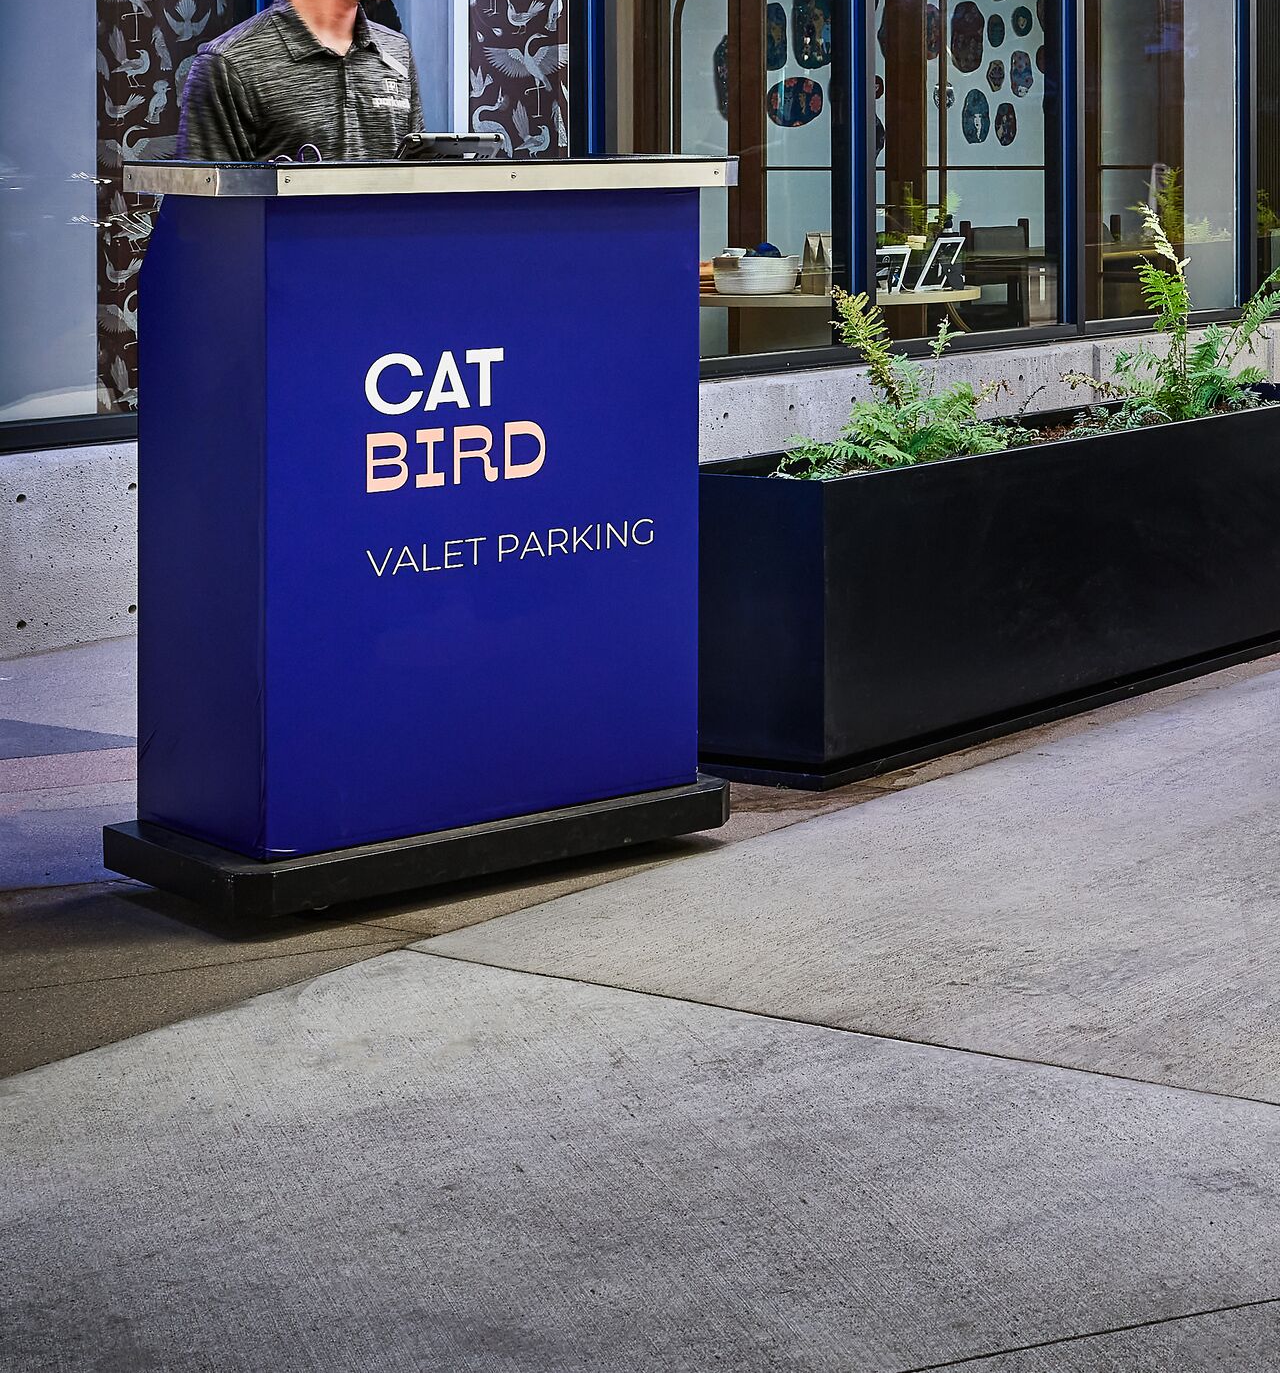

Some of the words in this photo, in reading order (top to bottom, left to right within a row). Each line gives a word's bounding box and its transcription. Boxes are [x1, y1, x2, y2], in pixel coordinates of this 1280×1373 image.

[364, 347, 505, 416] CAT
[365, 420, 547, 494] BIRD
[366, 537, 488, 577] VALET
[498, 518, 655, 563] PARKING
